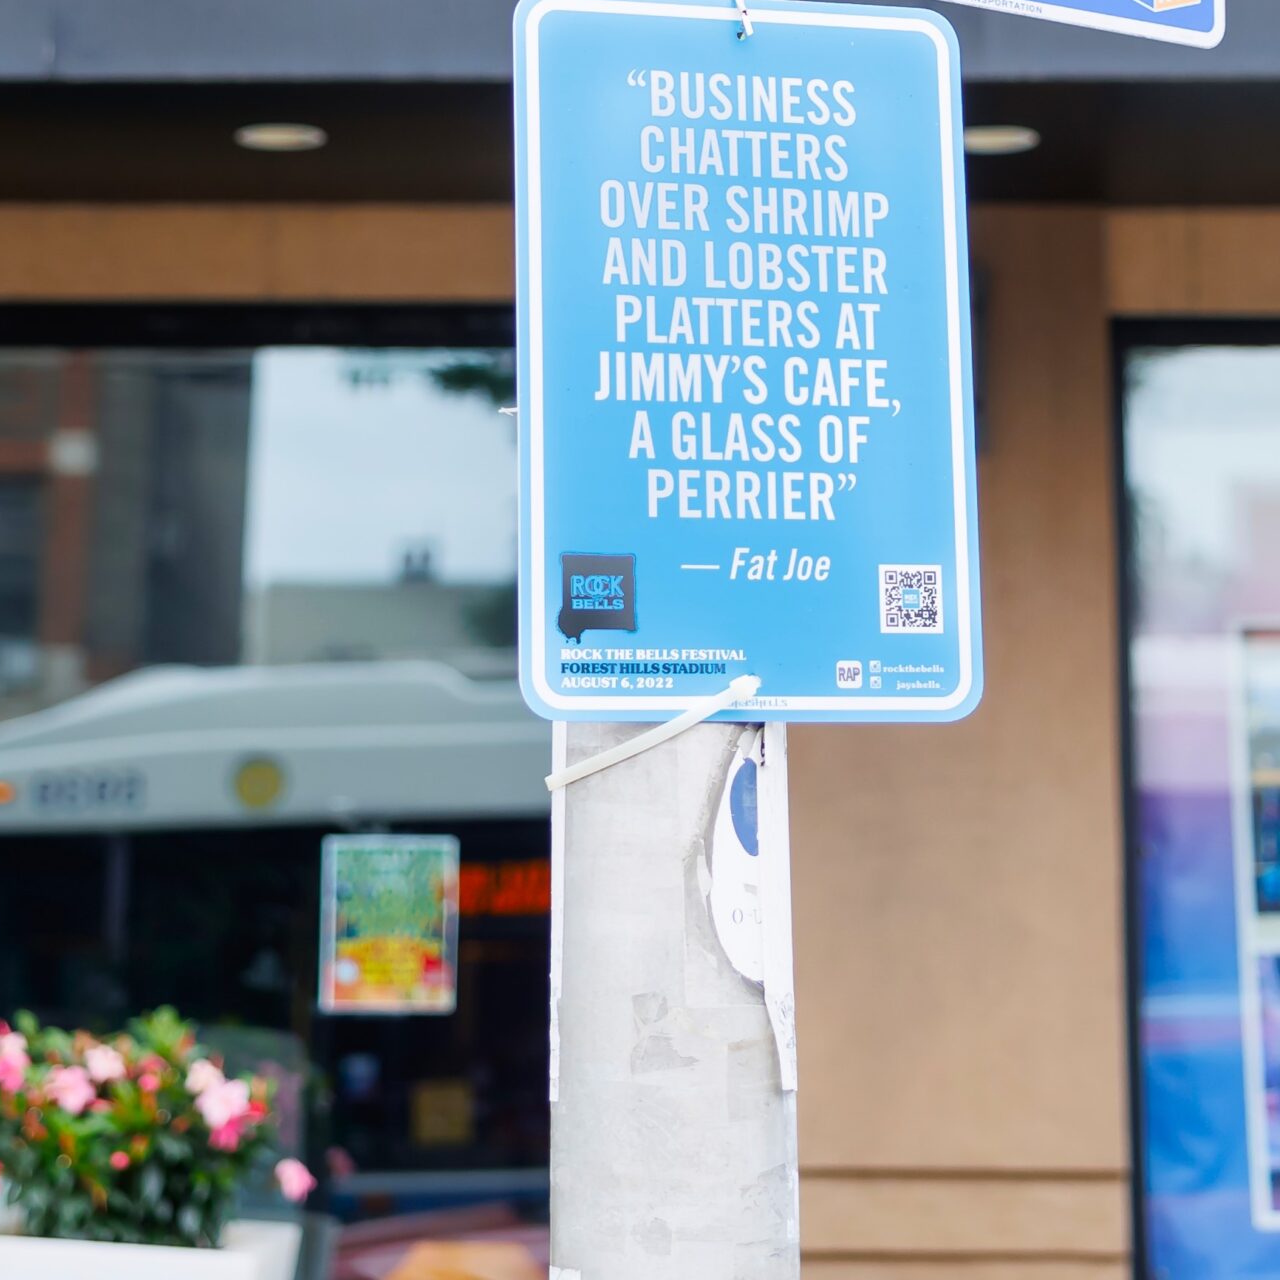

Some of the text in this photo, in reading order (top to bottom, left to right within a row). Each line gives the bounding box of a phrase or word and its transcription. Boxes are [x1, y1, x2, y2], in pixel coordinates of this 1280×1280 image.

[627, 68, 857, 127] “BUSINESS
[640, 125, 848, 182] CHATTERS
[599, 180, 890, 239] OVER SHRIMP
[602, 237, 889, 295] AND LOBSTER
[615, 295, 881, 351] PLATTERS AT
[594, 350, 902, 417] JIMMY’S CAFE,
[628, 410, 871, 465] A GLASS OF
[647, 469, 858, 521] PERRIER”
[570, 574, 625, 597] ROCK
[729, 547, 779, 582] Fat
[782, 548, 832, 583] Joe
[571, 598, 625, 610] BELLS
[560, 648, 747, 661] ROCK THE BELLS FESTIVAL
[560, 662, 726, 675] FOREST HILLS STADIUM
[837, 666, 861, 682] RAP
[882, 664, 945, 673] rockthebells
[560, 676, 674, 690] AUGUST 6, 2022
